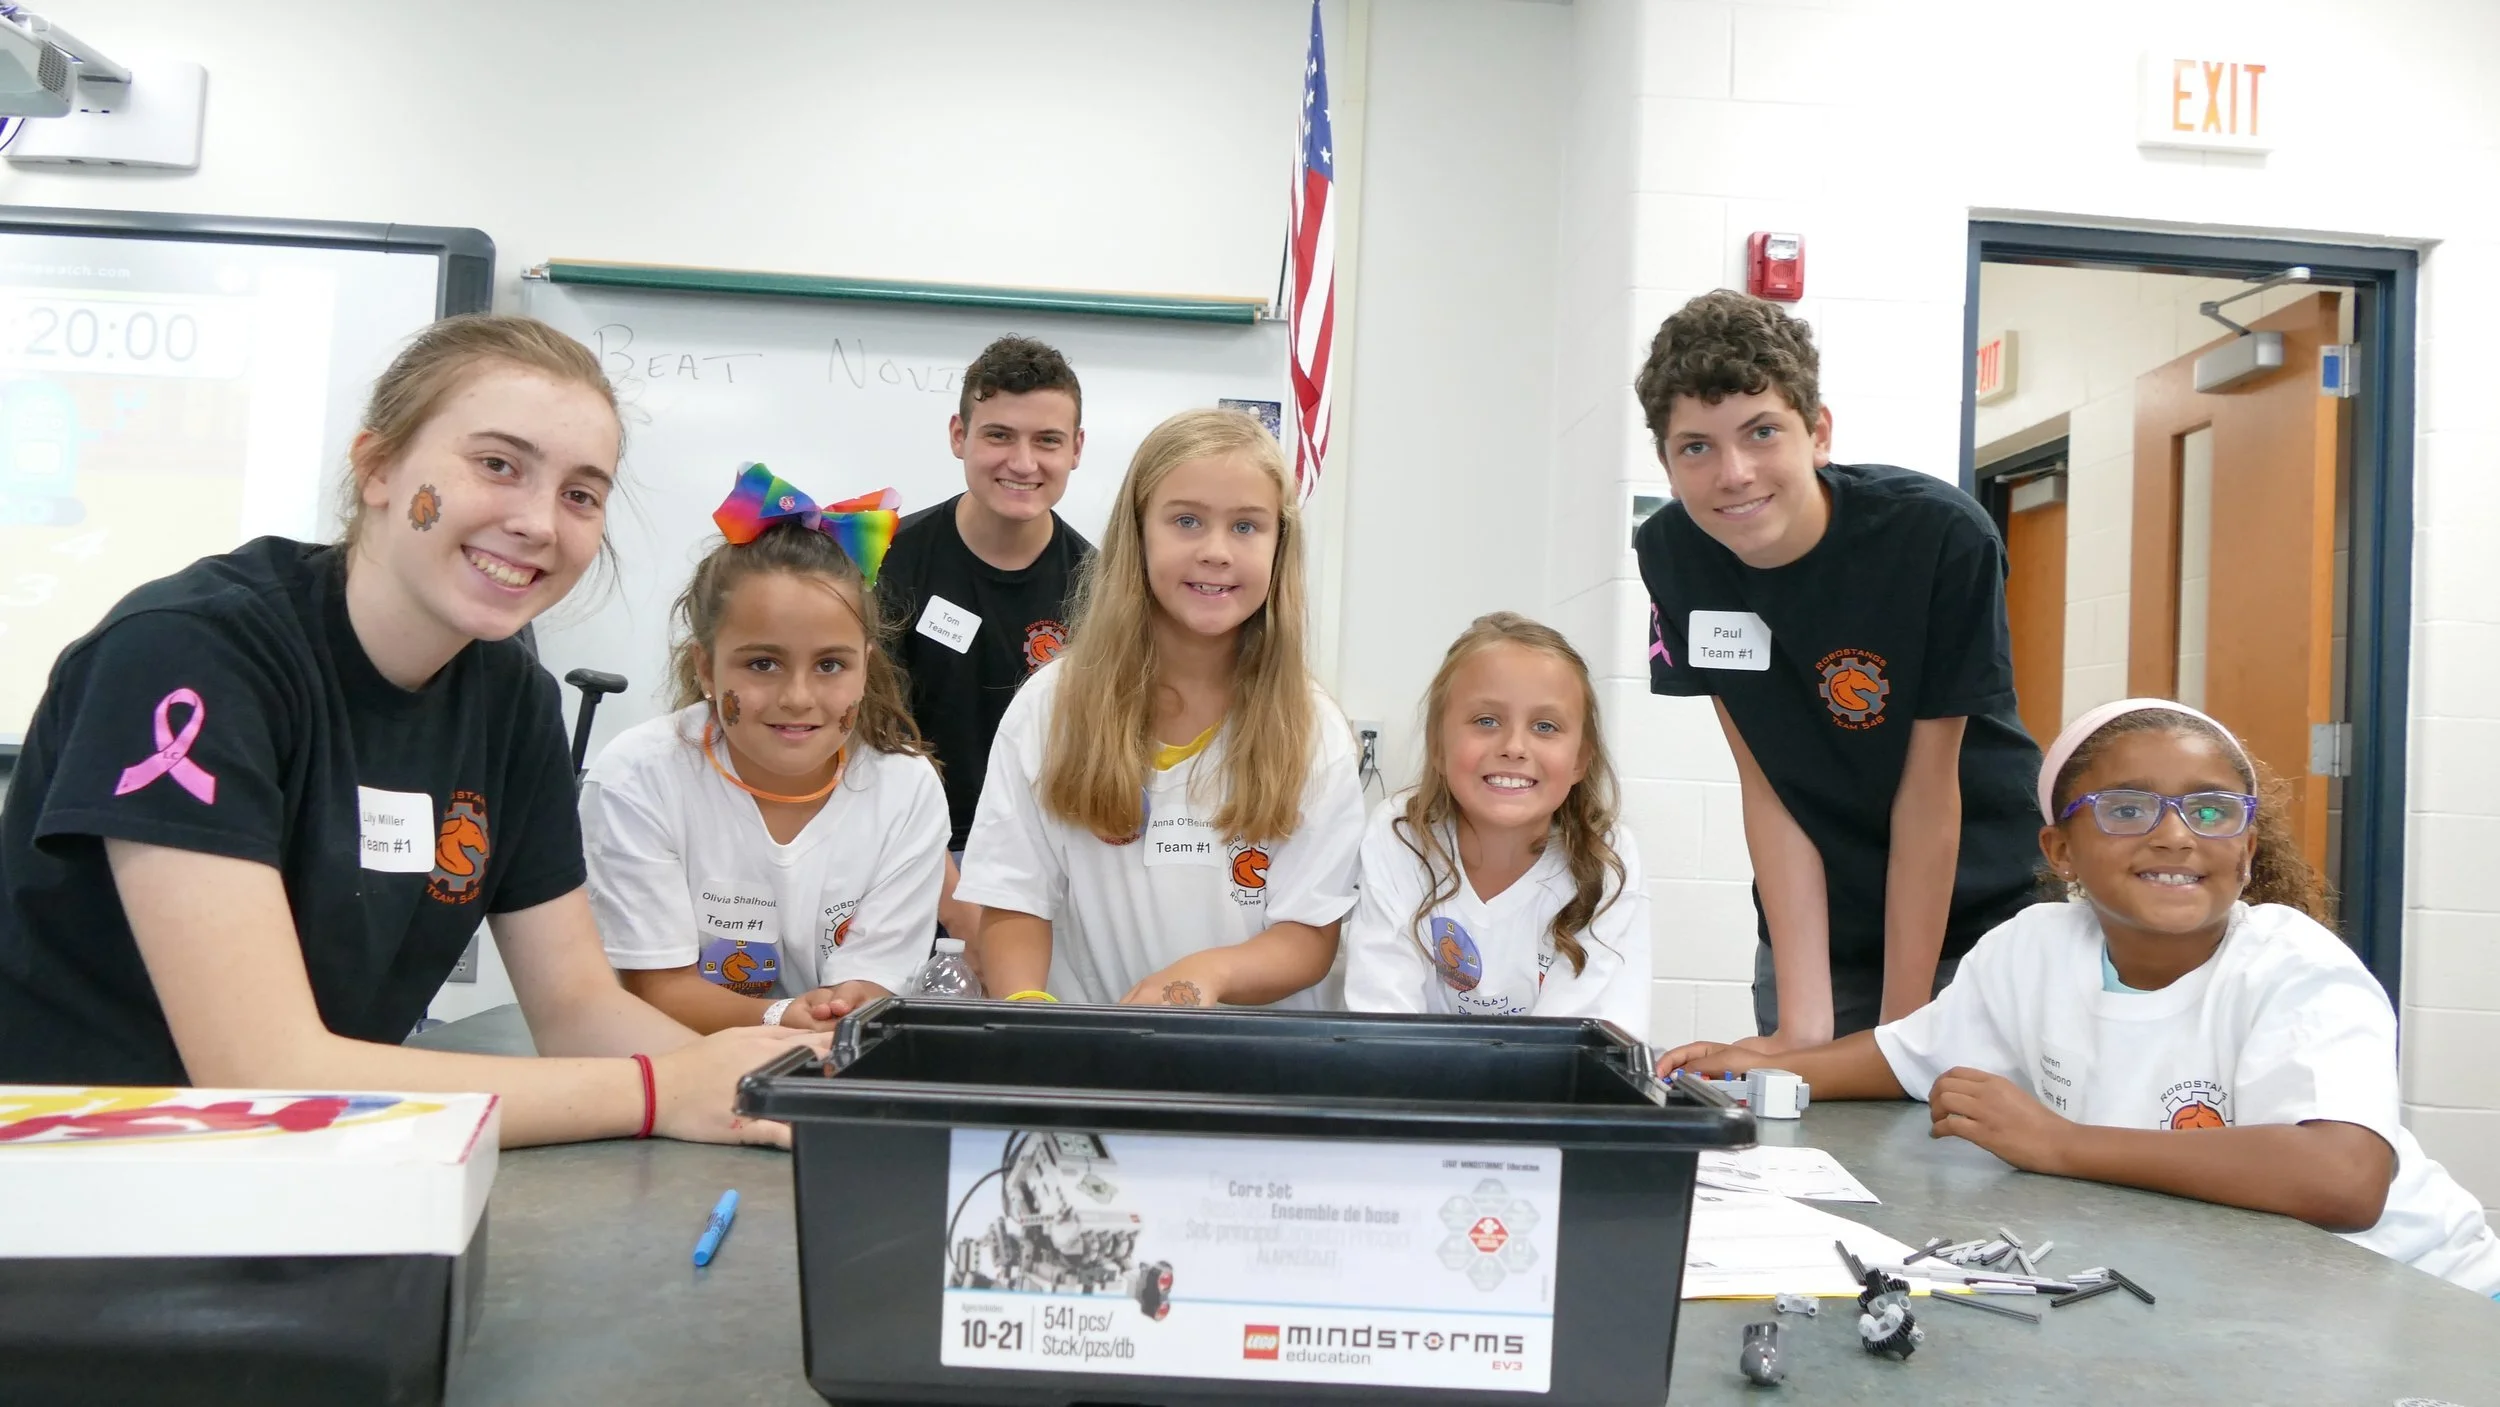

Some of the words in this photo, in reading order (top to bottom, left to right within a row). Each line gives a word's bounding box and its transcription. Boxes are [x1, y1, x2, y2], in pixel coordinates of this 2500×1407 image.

[2173, 59, 2266, 136] EXIT
[593, 324, 763, 384] BEAT
[1976, 340, 2001, 393] XIT
[943, 611, 960, 626] Tom
[928, 621, 951, 637] Team
[951, 633, 963, 643] #5
[1713, 627, 1742, 639] Paul
[1700, 647, 1735, 659] Team
[1738, 648, 1754, 659] #1
[1815, 648, 1887, 670] ROBOSTANGS
[1832, 714, 1858, 730] TEAM
[362, 809, 376, 827] Lily
[378, 814, 406, 827] Miller
[1152, 819, 1175, 829] Anna
[360, 834, 389, 853] Team
[393, 838, 411, 853] #1
[1156, 841, 1193, 854] Team
[1196, 841, 1211, 854] #1
[702, 891, 731, 905] Olivia
[706, 914, 743, 930] Team
[747, 919, 764, 931] #1
[1457, 990, 1508, 1009] Gabby
[2055, 1095, 2067, 1111] #1
[1228, 1180, 1263, 1198] Core
[1266, 1181, 1293, 1200] Set
[1271, 1203, 1340, 1223] Ensemble
[1343, 1204, 1362, 1223] de
[1364, 1205, 1400, 1225] base
[960, 1319, 1024, 1351] 10-21
[1044, 1305, 1075, 1331] 541
[1078, 1311, 1114, 1335] pcs/
[1285, 1348, 1372, 1366] education
[1491, 1360, 1523, 1371] EV3
